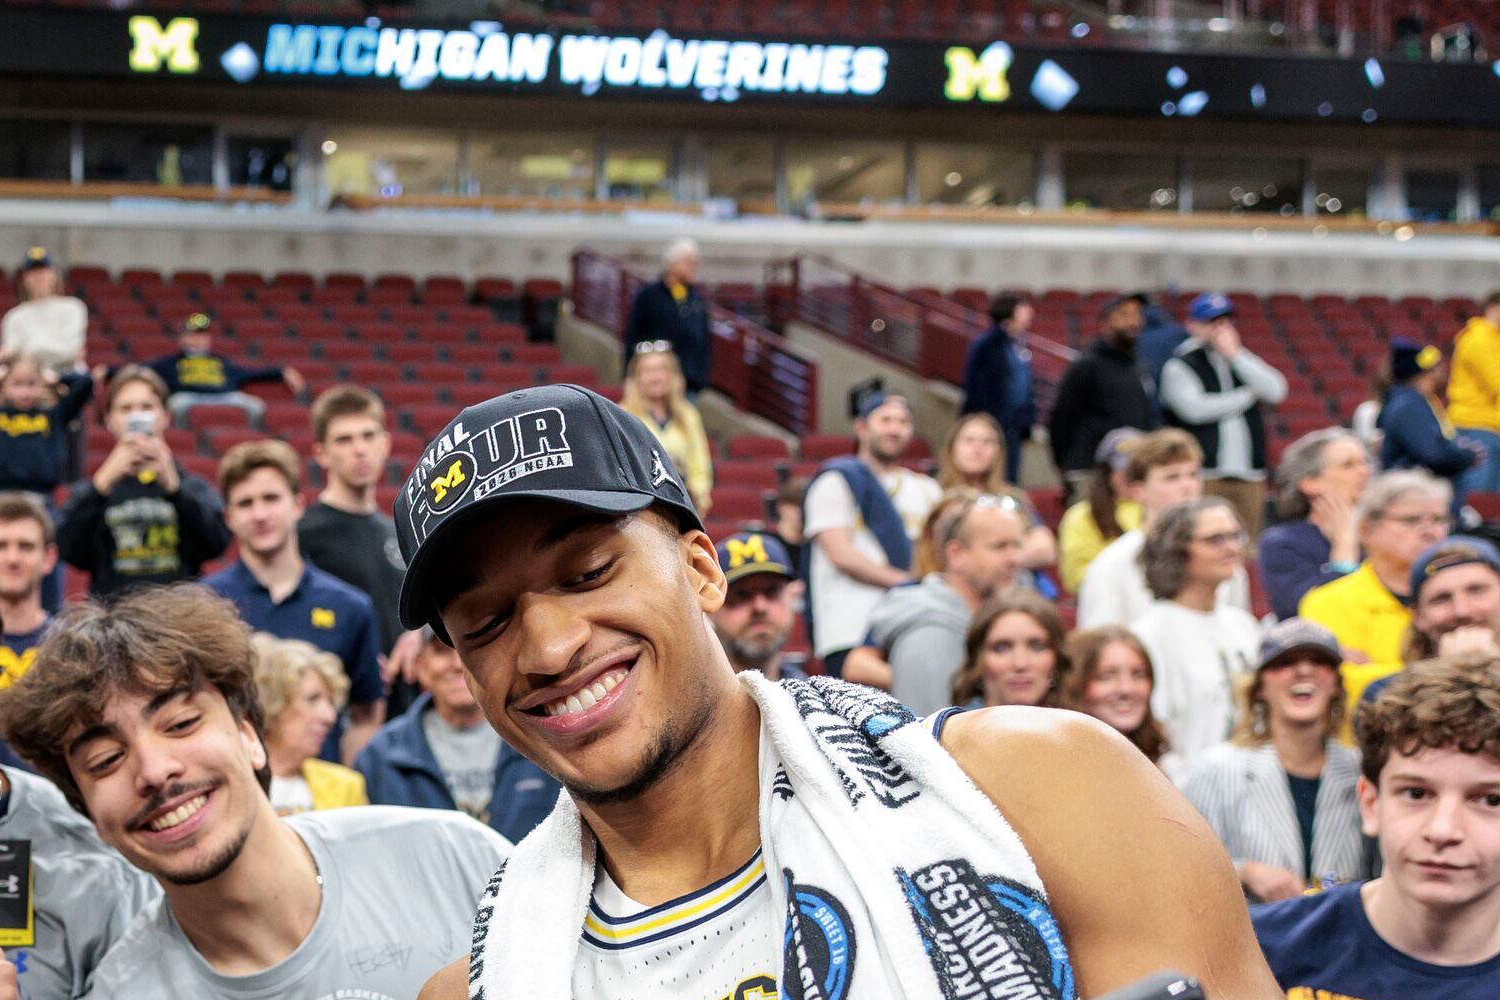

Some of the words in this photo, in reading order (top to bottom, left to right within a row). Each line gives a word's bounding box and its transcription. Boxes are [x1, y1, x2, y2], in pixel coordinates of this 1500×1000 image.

[128, 15, 199, 73] M
[263, 24, 553, 82] MICHIGAN
[559, 35, 889, 96] WOLVERINES
[944, 46, 1011, 102] M
[407, 422, 470, 506] FINAL
[430, 459, 466, 504] M
[478, 468, 518, 497] 2026
[524, 454, 566, 473] NCAA
[726, 533, 769, 568] M
[814, 906, 845, 945] SWEET
